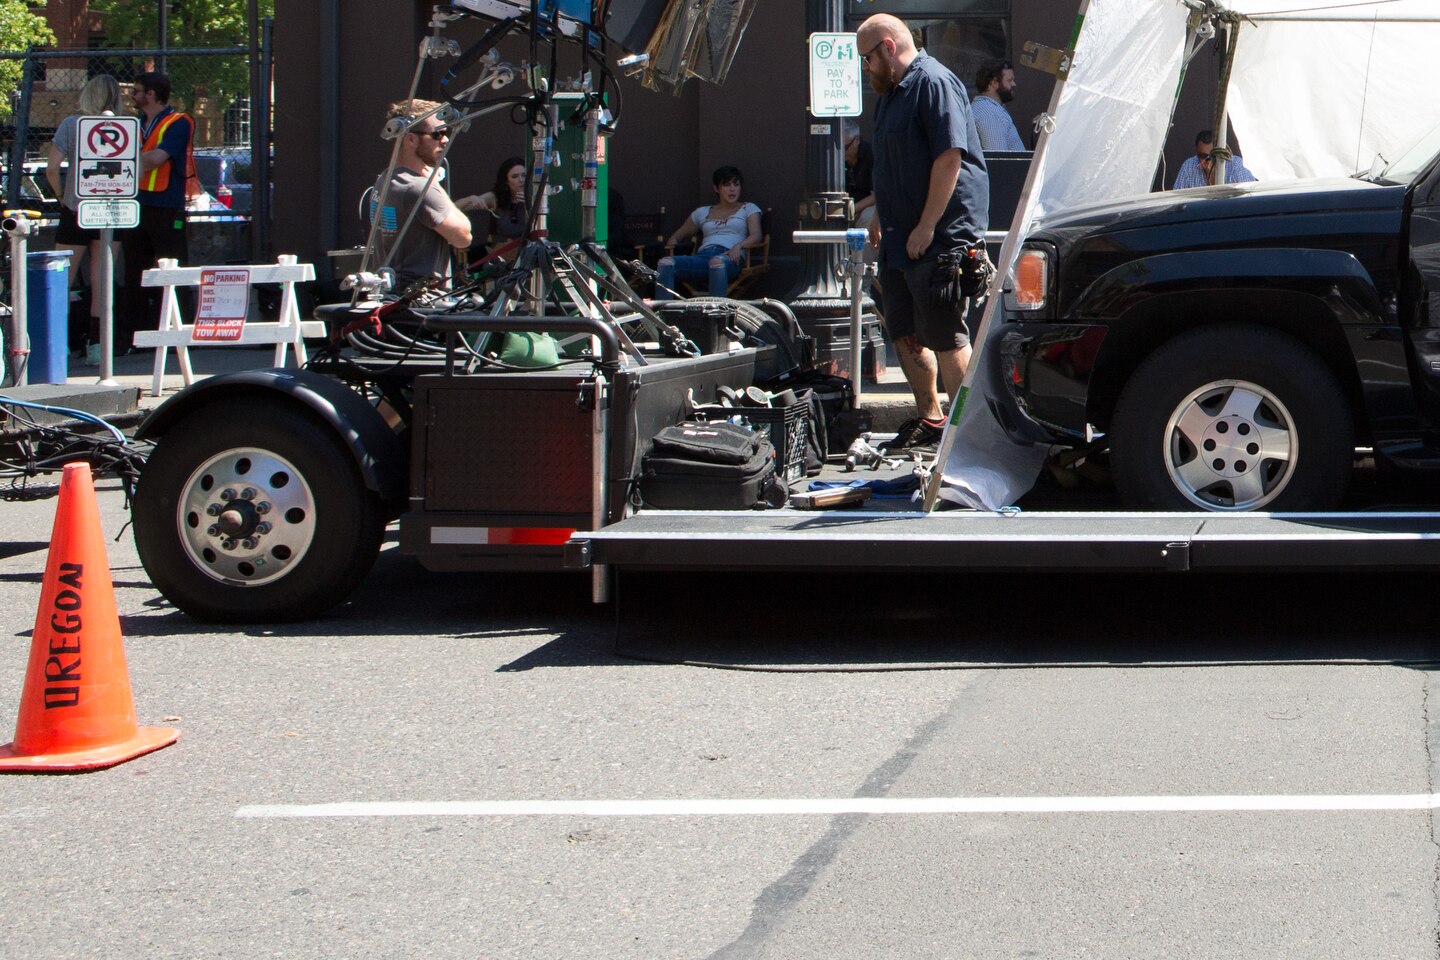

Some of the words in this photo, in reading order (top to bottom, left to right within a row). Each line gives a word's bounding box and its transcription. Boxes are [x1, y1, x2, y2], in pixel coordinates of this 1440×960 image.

[827, 68, 845, 78] PAY
[830, 79, 843, 89] TO
[824, 89, 849, 99] PARK
[204, 274, 215, 283] NO
[216, 274, 246, 282] PARKING
[197, 319, 216, 327] THIS
[217, 319, 242, 327] BLOCK
[195, 328, 215, 337] TOW
[215, 328, 239, 337] AWAY
[44, 562, 85, 711] OREGON
